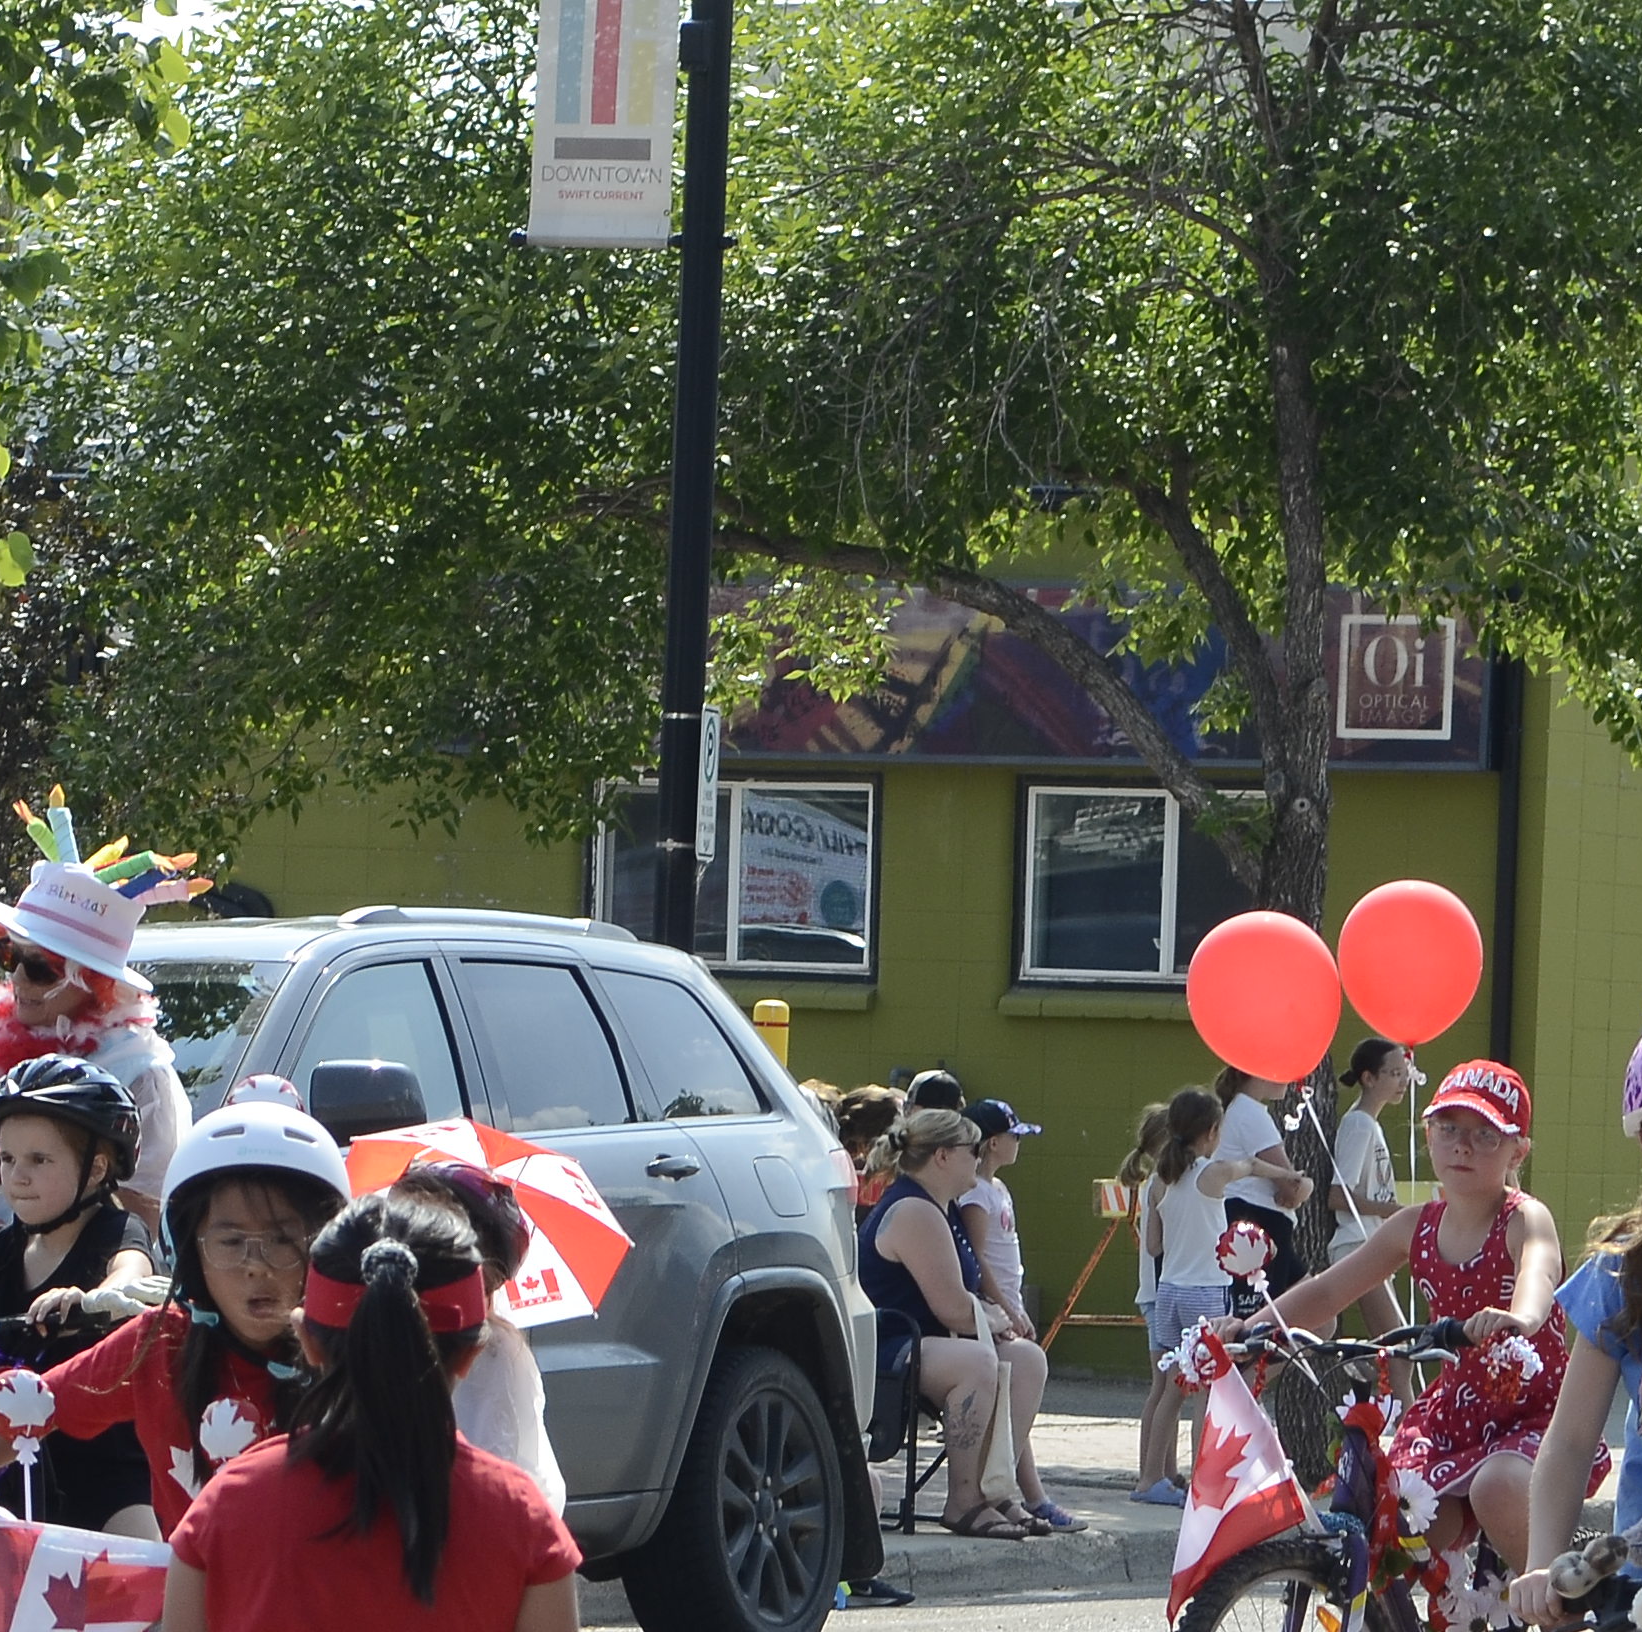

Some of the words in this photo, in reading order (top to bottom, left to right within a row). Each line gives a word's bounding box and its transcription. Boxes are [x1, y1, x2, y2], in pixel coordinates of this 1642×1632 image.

[541, 165, 662, 184] DOWNTOWN
[558, 189, 590, 200] SWIFT
[593, 190, 644, 201] CURRENT
[1363, 634, 1428, 688] Oi
[1359, 693, 1429, 709] OPTICAL
[1359, 709, 1428, 725] IMAGE
[1439, 1067, 1519, 1115] CANADA
